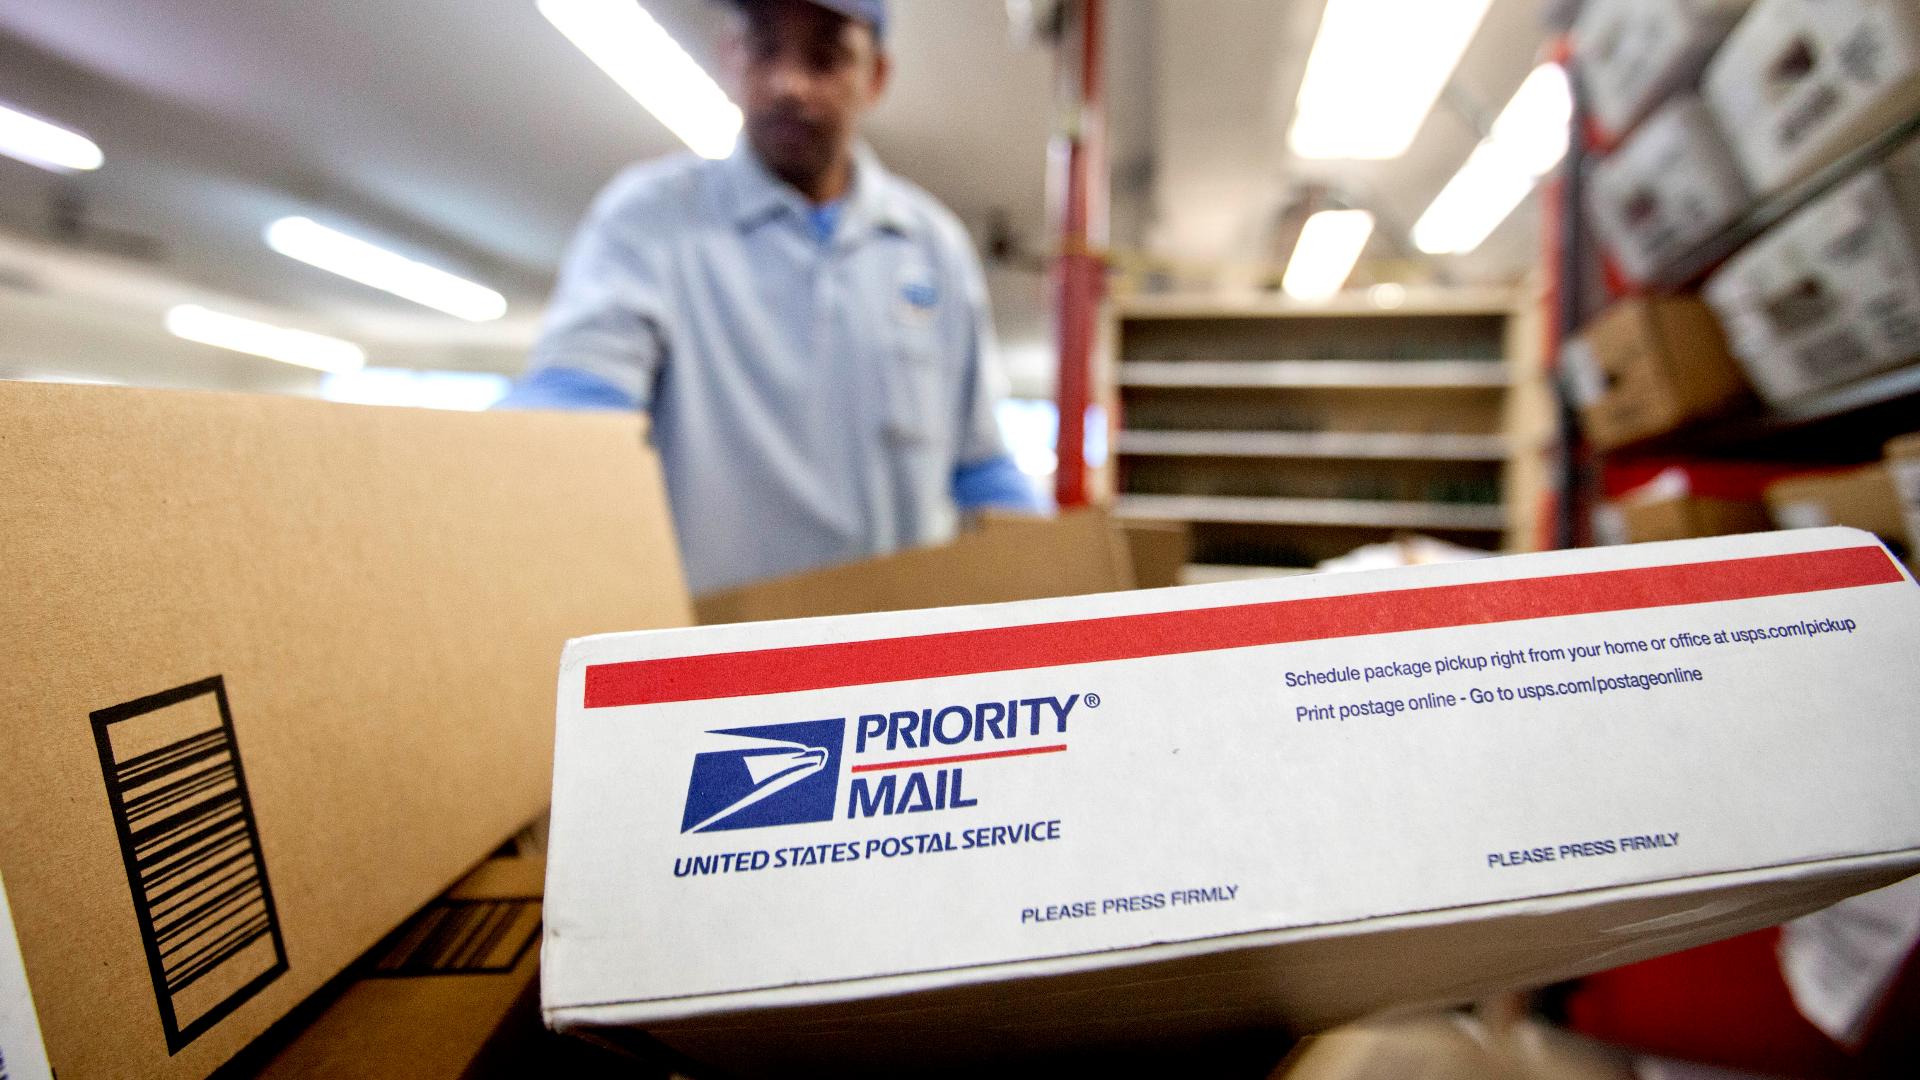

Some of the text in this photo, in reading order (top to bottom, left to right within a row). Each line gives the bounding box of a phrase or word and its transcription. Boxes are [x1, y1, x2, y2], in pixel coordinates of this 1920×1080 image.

[1285, 618, 1856, 687] Schedule package pickup right from your home or office at usps.com/pickup
[1296, 704, 1336, 722] Print
[1339, 700, 1405, 721] postage
[1409, 693, 1456, 710] online
[1470, 688, 1494, 704] Go
[1497, 687, 1514, 701] to
[1517, 668, 1703, 701] usps.com/postageonline
[847, 768, 978, 819] MAIL
[673, 820, 1061, 878] UNITED STATES POSTAL SERVICE
[1488, 832, 1679, 868] PLEASE PRESS FIRMLY
[1021, 885, 1238, 924] PLEASE PRESS FIRMLY
